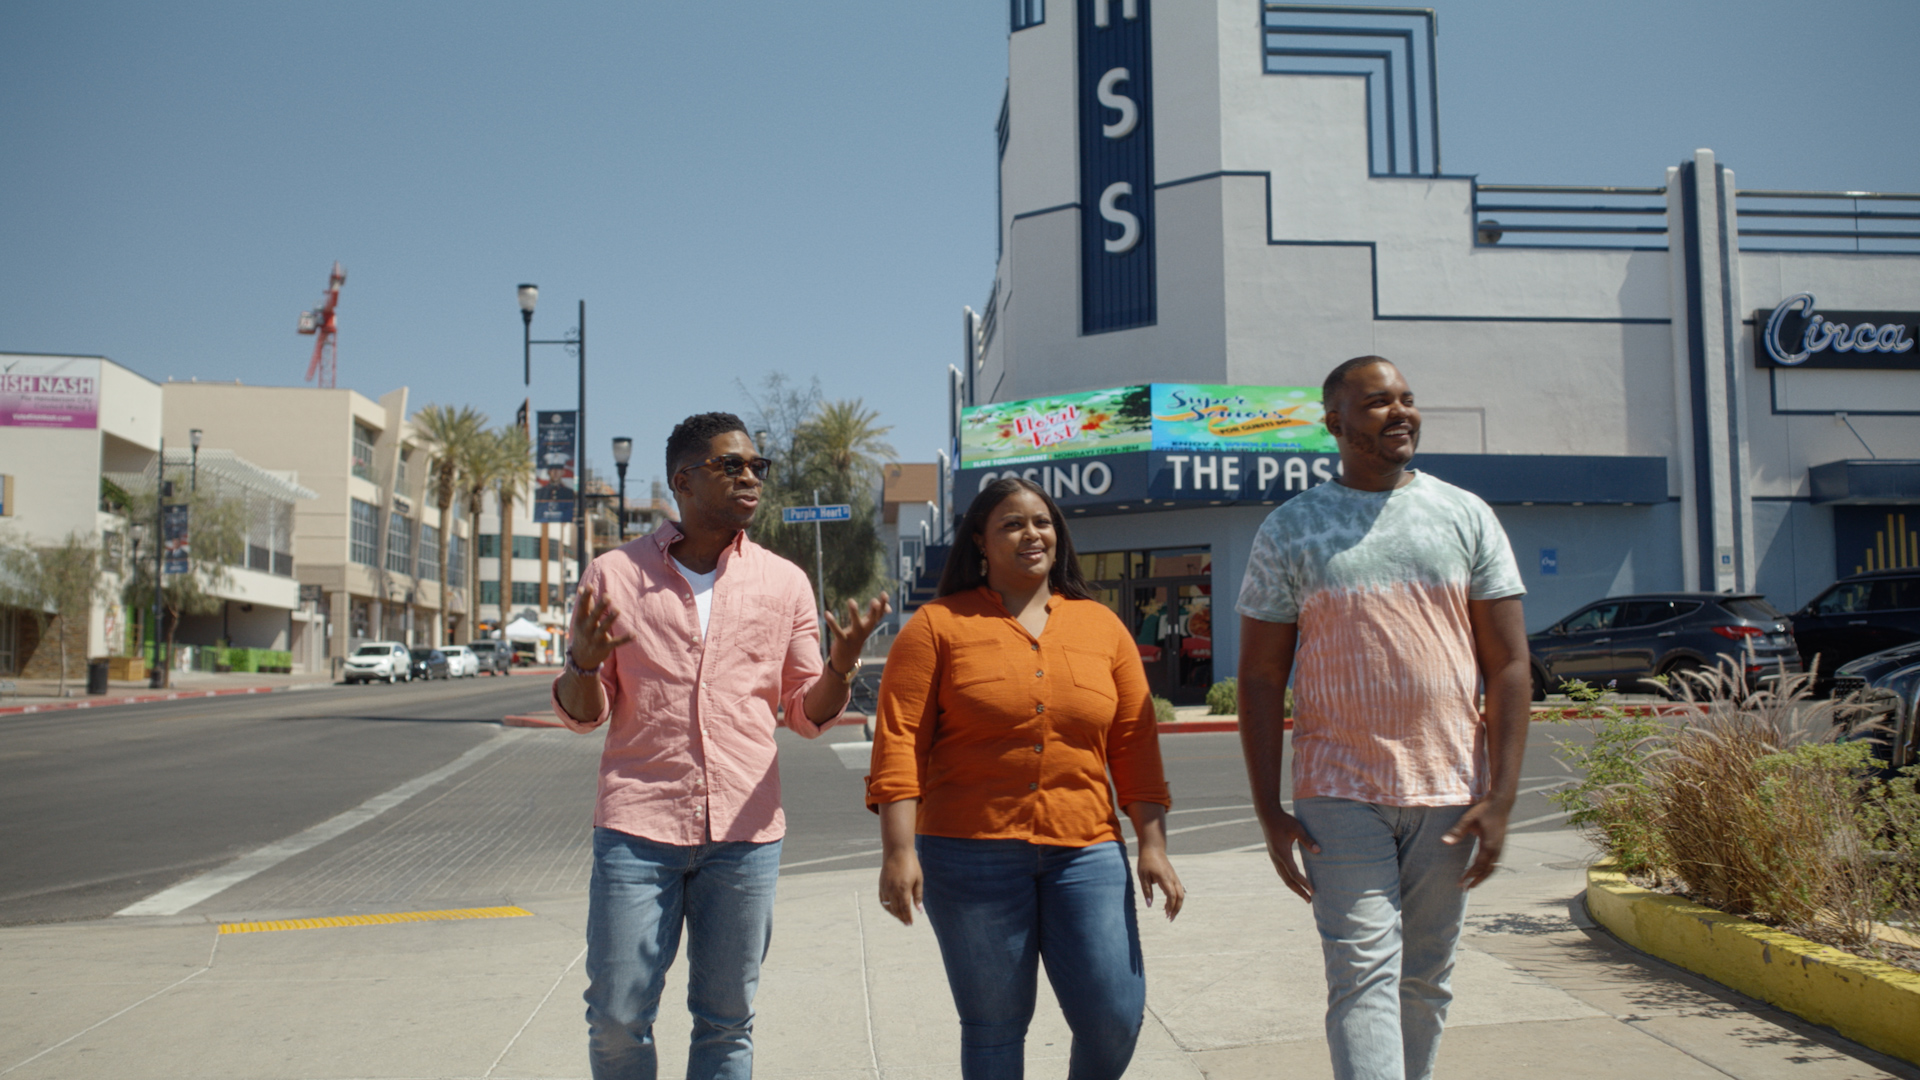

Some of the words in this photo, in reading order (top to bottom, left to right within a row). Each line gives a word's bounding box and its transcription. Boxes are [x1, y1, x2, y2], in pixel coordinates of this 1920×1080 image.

[1765, 291, 1914, 365] Circa
[39, 377, 93, 393] NASH
[1167, 390, 1248, 410] Super
[1014, 405, 1080, 435] Floral
[1184, 405, 1286, 422] Seniors
[1032, 423, 1077, 449] Fest
[1219, 426, 1240, 434] FOR
[993, 454, 1047, 465] TOURNAMENT
[979, 461, 1112, 500] CSINO
[1166, 456, 1240, 490] THE
[1258, 457, 1344, 491] PAS
[790, 508, 816, 521] Purple
[820, 507, 842, 518] Heart
